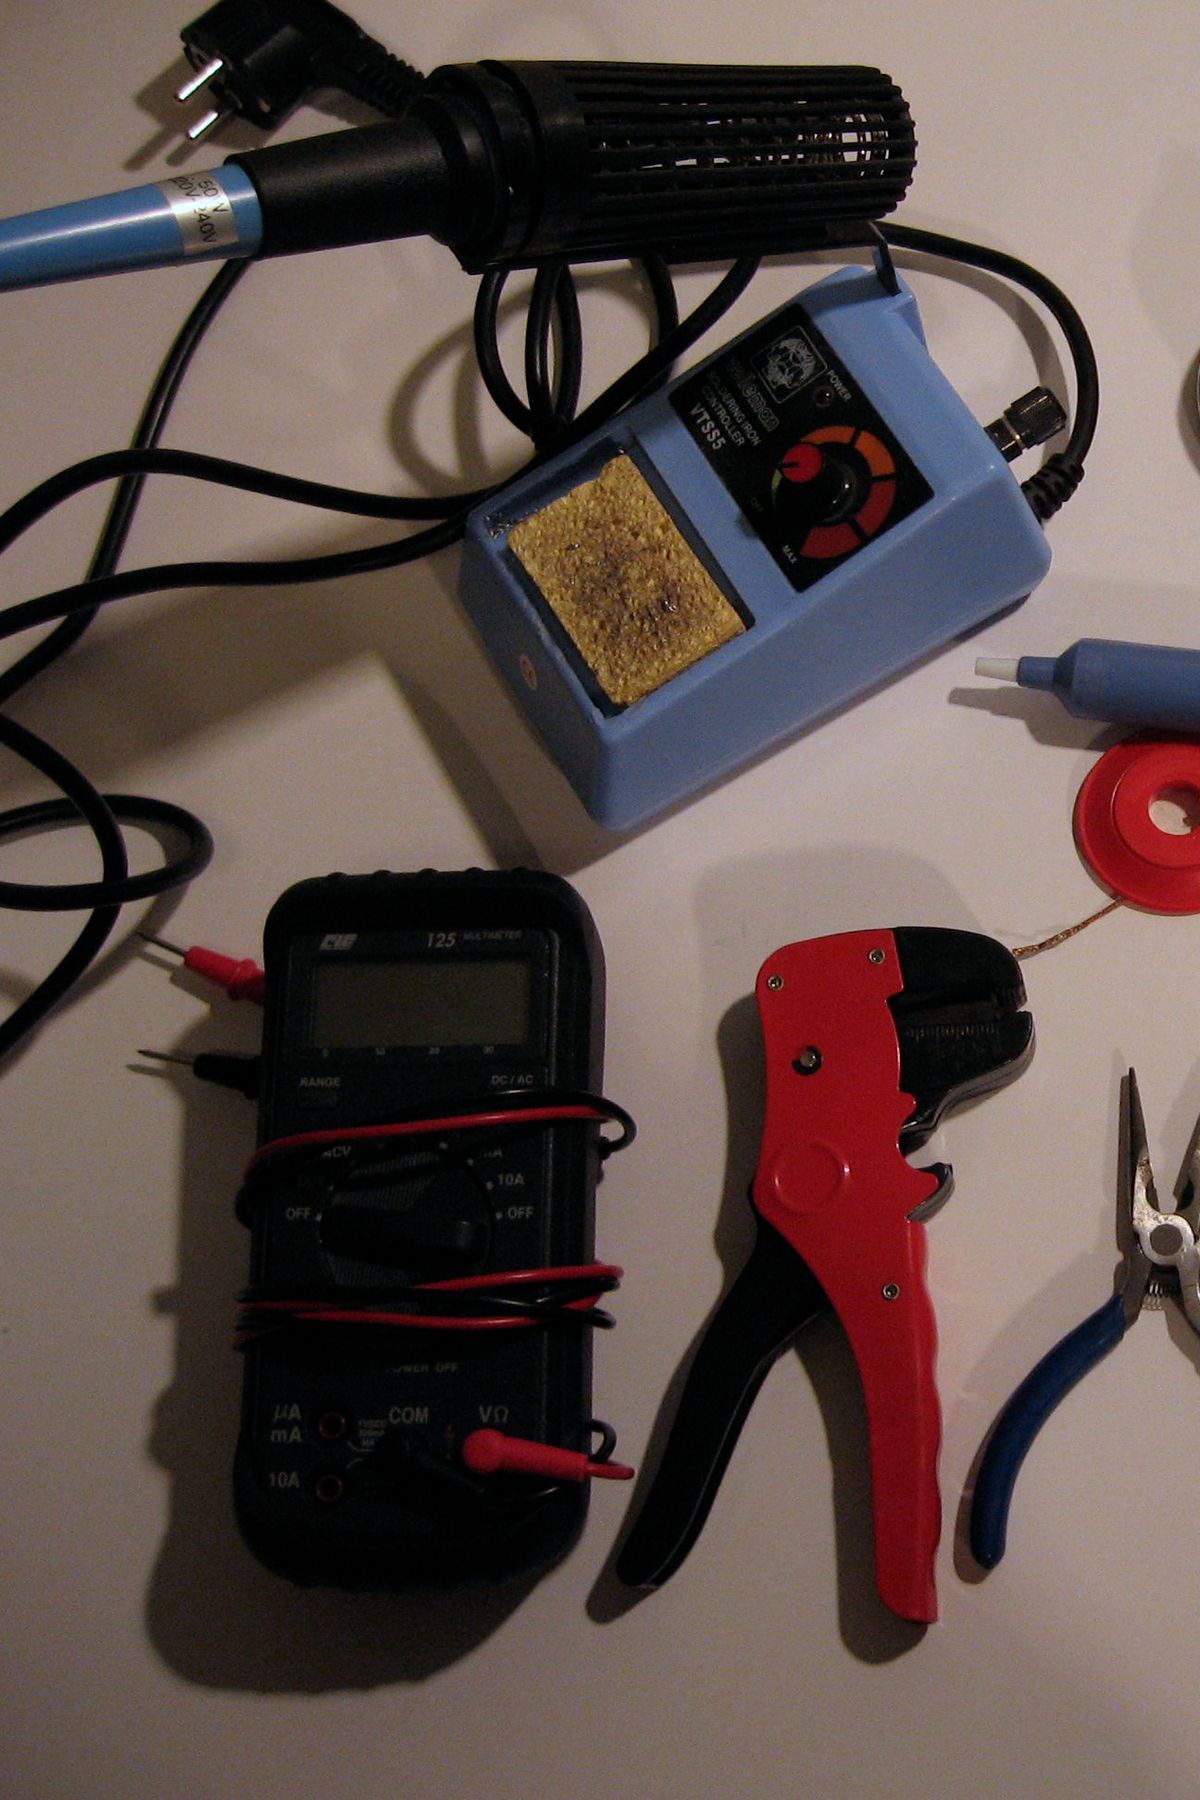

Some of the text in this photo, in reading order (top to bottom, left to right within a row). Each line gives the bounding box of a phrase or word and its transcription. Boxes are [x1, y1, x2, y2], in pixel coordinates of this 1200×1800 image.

[826, 369, 853, 404] POWER
[701, 385, 747, 447] CONTROLLER
[688, 401, 727, 451] VTSS5
[739, 416, 762, 448] IRON
[781, 543, 800, 565] MAX
[427, 931, 458, 949] 125
[463, 930, 524, 942] MULTIMETER
[299, 1075, 342, 1089] RANGE
[491, 1073, 508, 1086] DC
[516, 1073, 535, 1086] AC
[497, 1172, 526, 1186] 10A
[286, 1205, 534, 1221] OFF OFF
[434, 1361, 459, 1374] OFF
[388, 1406, 431, 1425] COM
[270, 1426, 302, 1444] mA
[268, 1471, 301, 1489] 10A
